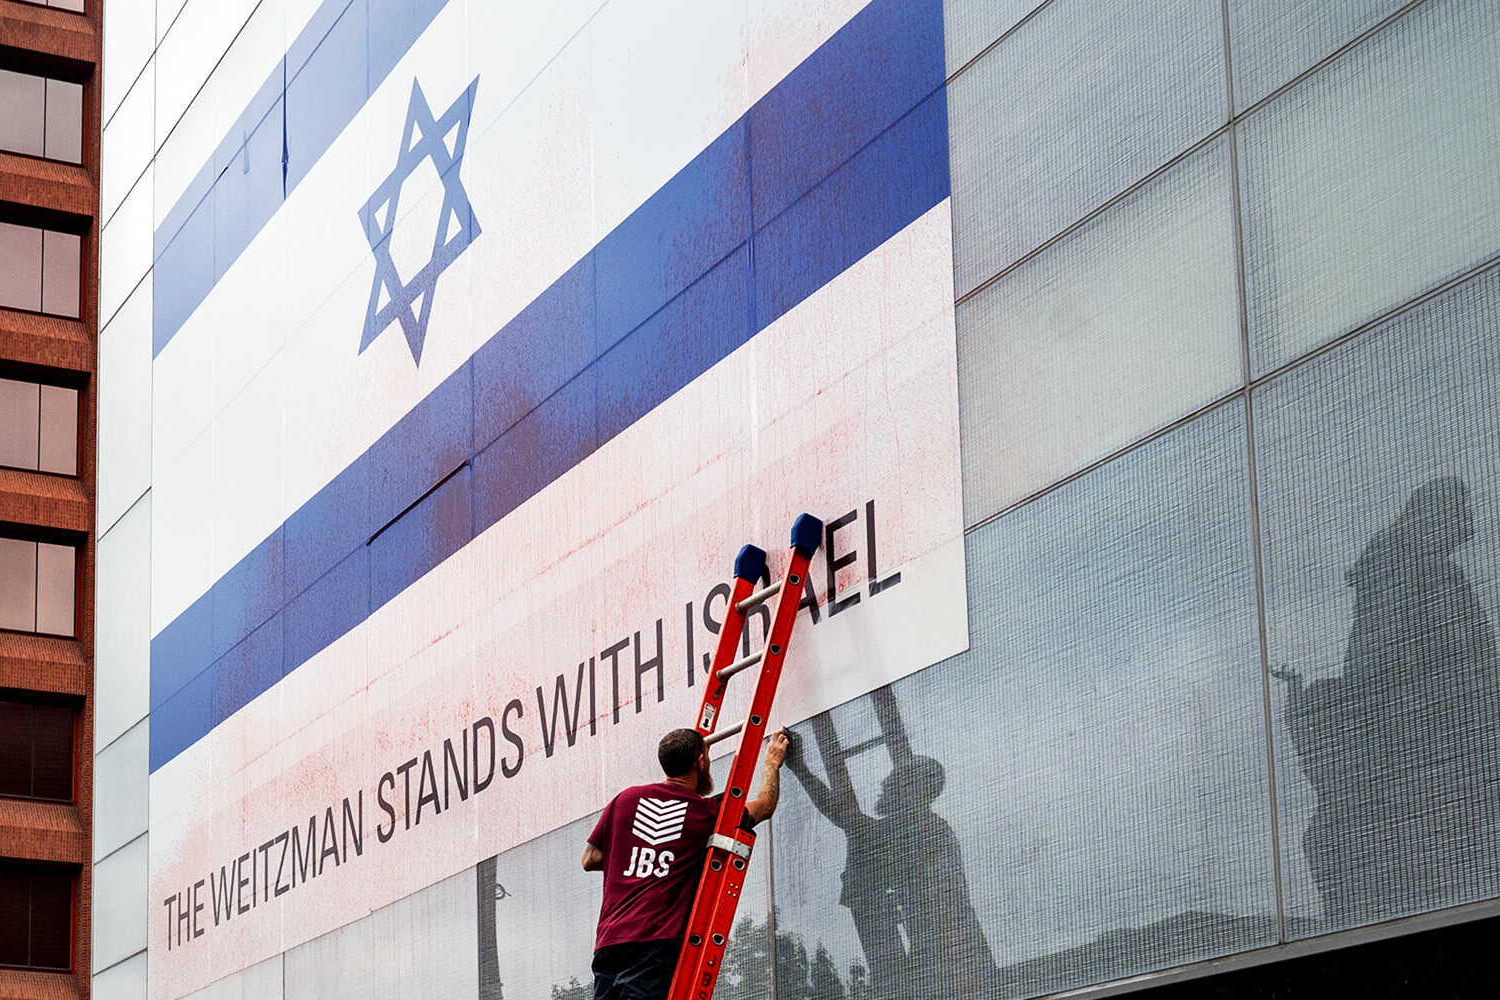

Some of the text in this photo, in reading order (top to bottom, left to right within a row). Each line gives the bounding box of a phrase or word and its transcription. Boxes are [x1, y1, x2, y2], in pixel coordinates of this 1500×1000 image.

[164, 878, 205, 951] THE
[210, 789, 363, 927] WEITZMAN
[376, 697, 524, 844] STANDS
[536, 618, 665, 758] WITH
[623, 846, 675, 878] JBS
